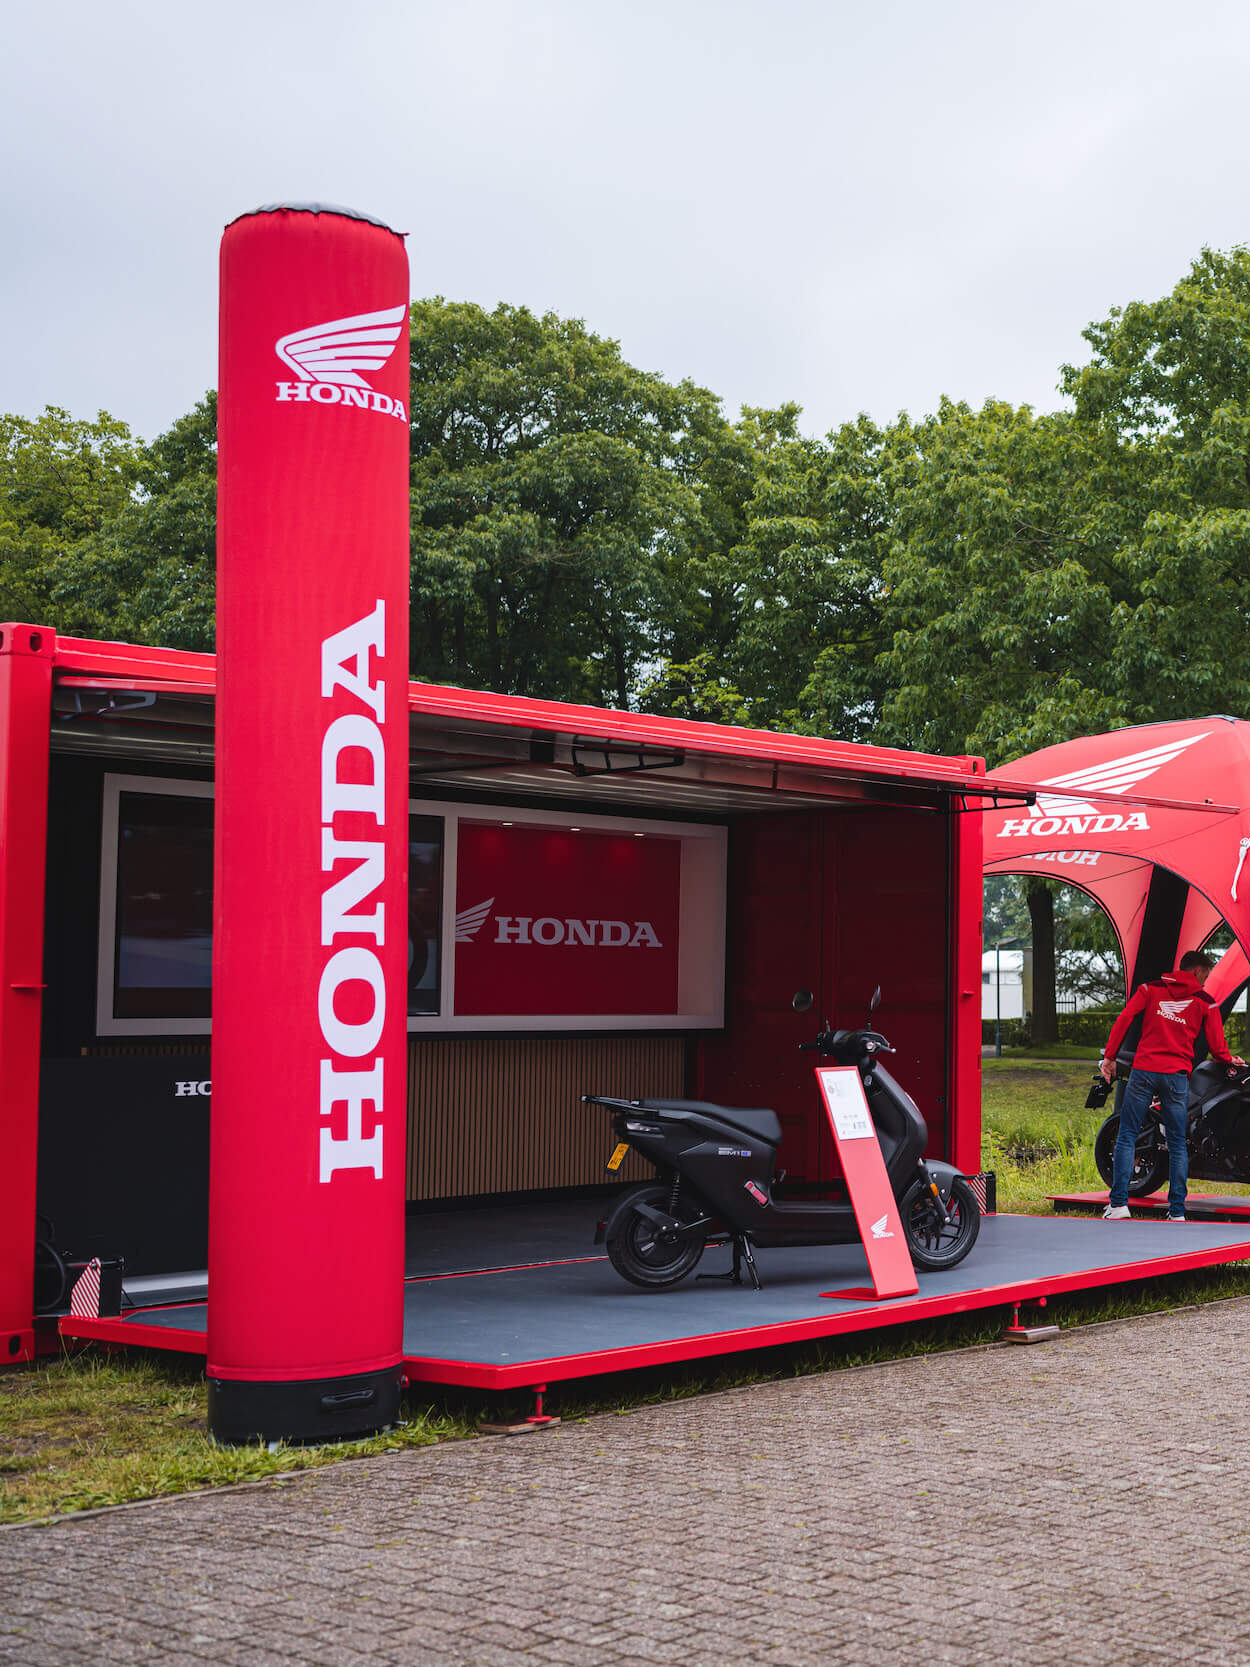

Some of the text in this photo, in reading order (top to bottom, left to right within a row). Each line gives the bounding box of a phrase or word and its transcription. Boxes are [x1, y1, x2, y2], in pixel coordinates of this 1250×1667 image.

[275, 382, 407, 422] HONDA
[996, 812, 1150, 838] HONDA
[318, 598, 386, 1184] HONDA
[494, 916, 664, 948] HONDA
[1157, 1010, 1187, 1025] HONDA
